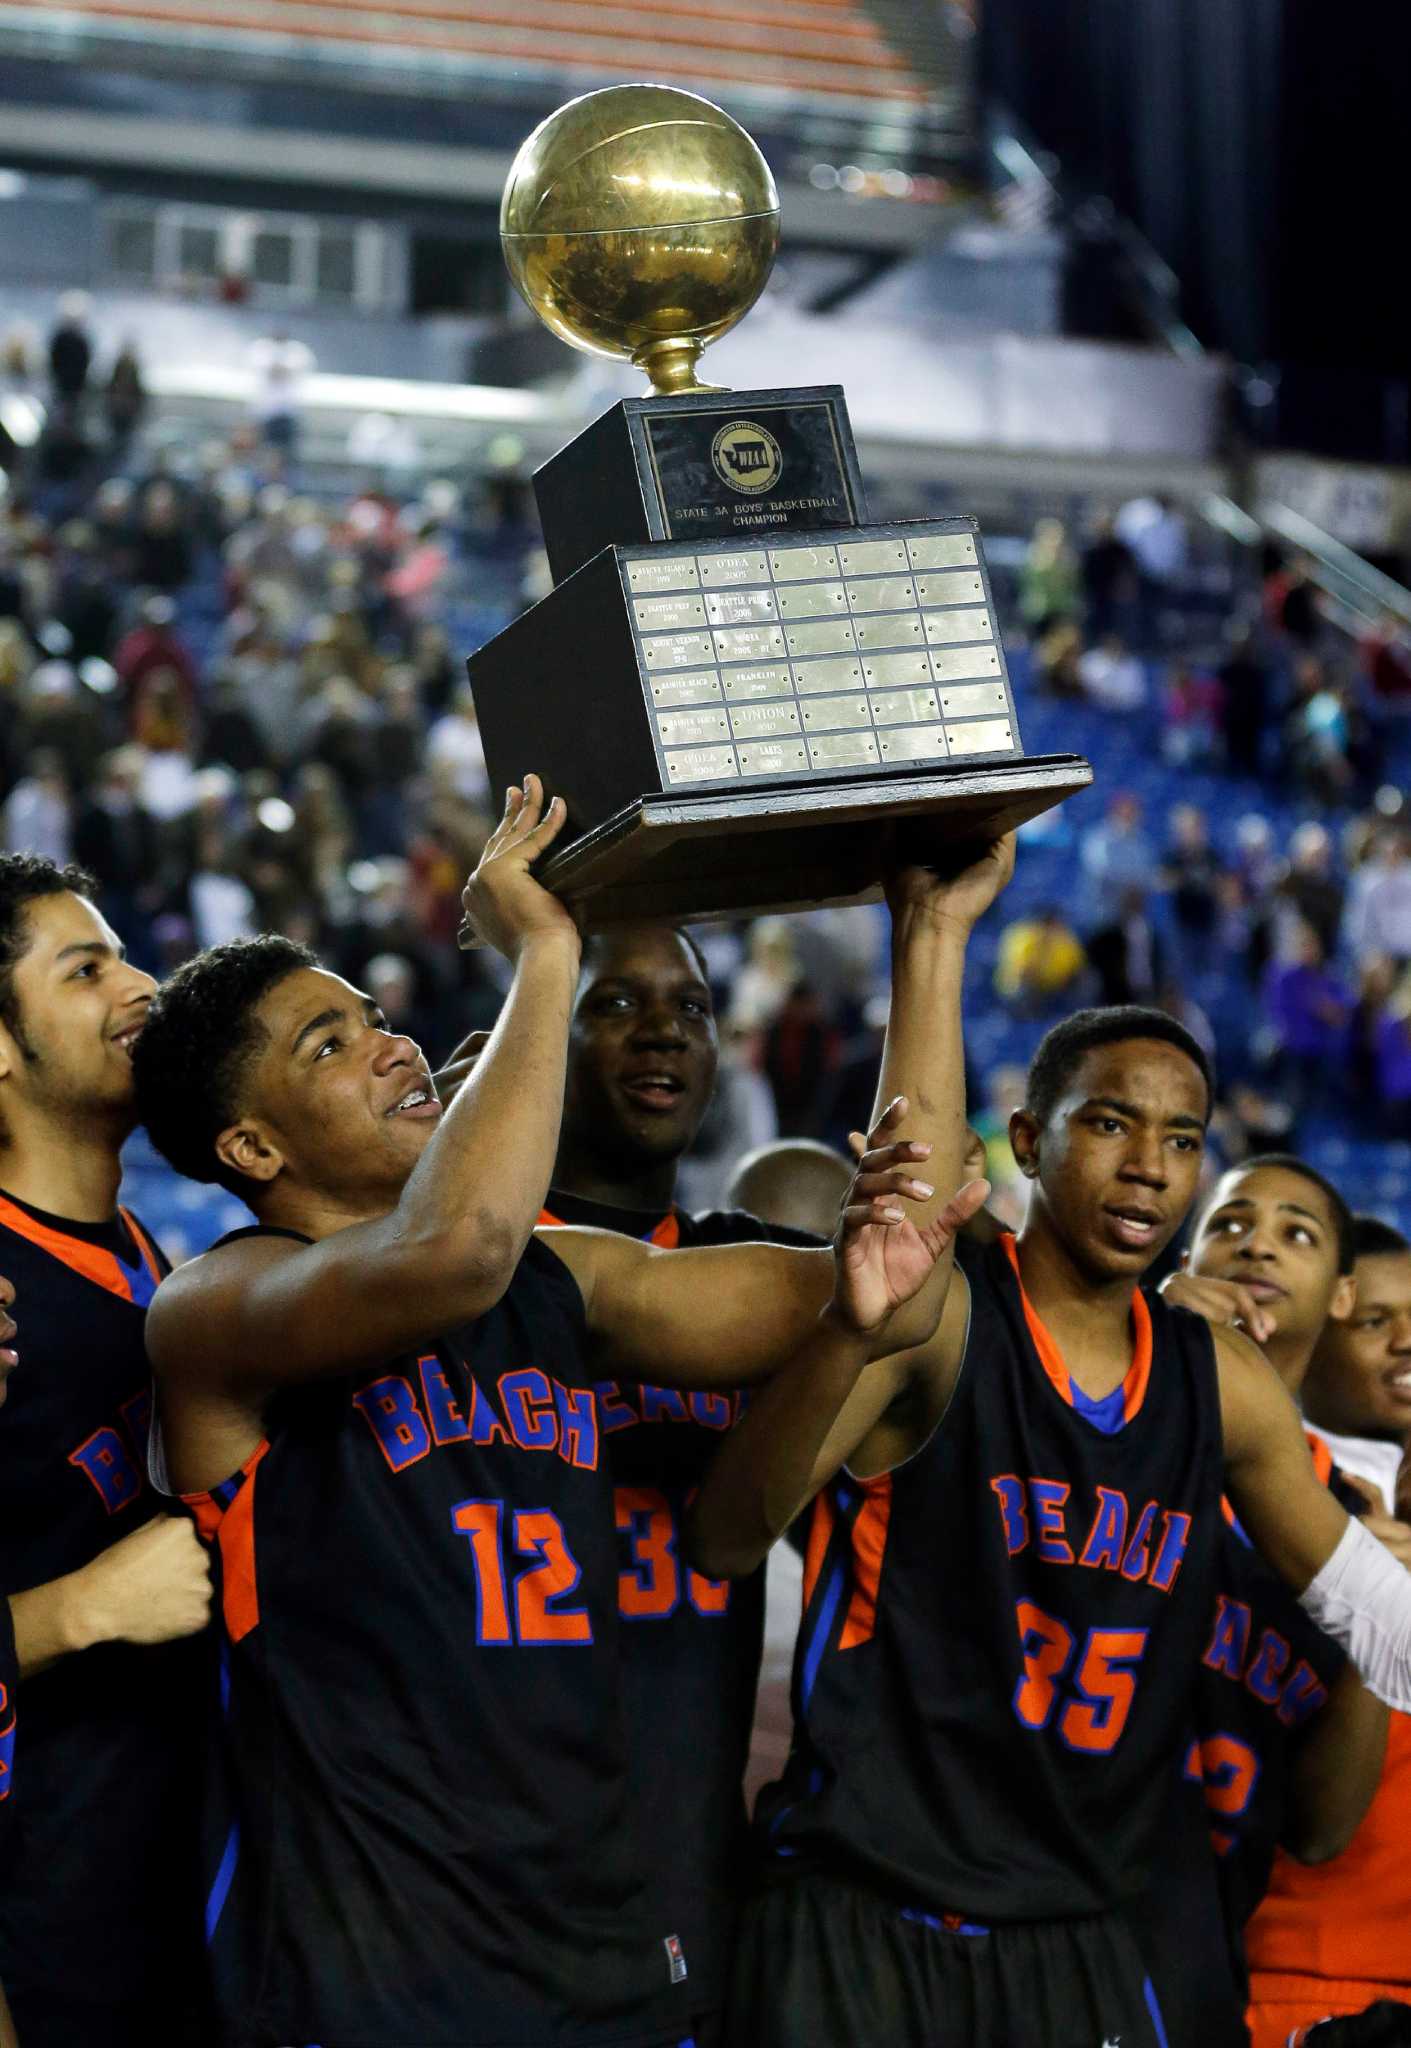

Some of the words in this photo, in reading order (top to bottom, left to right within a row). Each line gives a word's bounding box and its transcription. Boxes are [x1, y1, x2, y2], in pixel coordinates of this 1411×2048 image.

[738, 449, 768, 466] WIAA
[675, 507, 708, 519] STATE
[714, 506, 729, 516] 3A
[771, 497, 839, 512] BASKETBALL
[732, 513, 788, 526] CHAMPION
[743, 707, 785, 720] UNION
[352, 1354, 598, 1475] BEACH
[990, 1473, 1192, 1595] BEACH
[450, 1498, 594, 1646] 12
